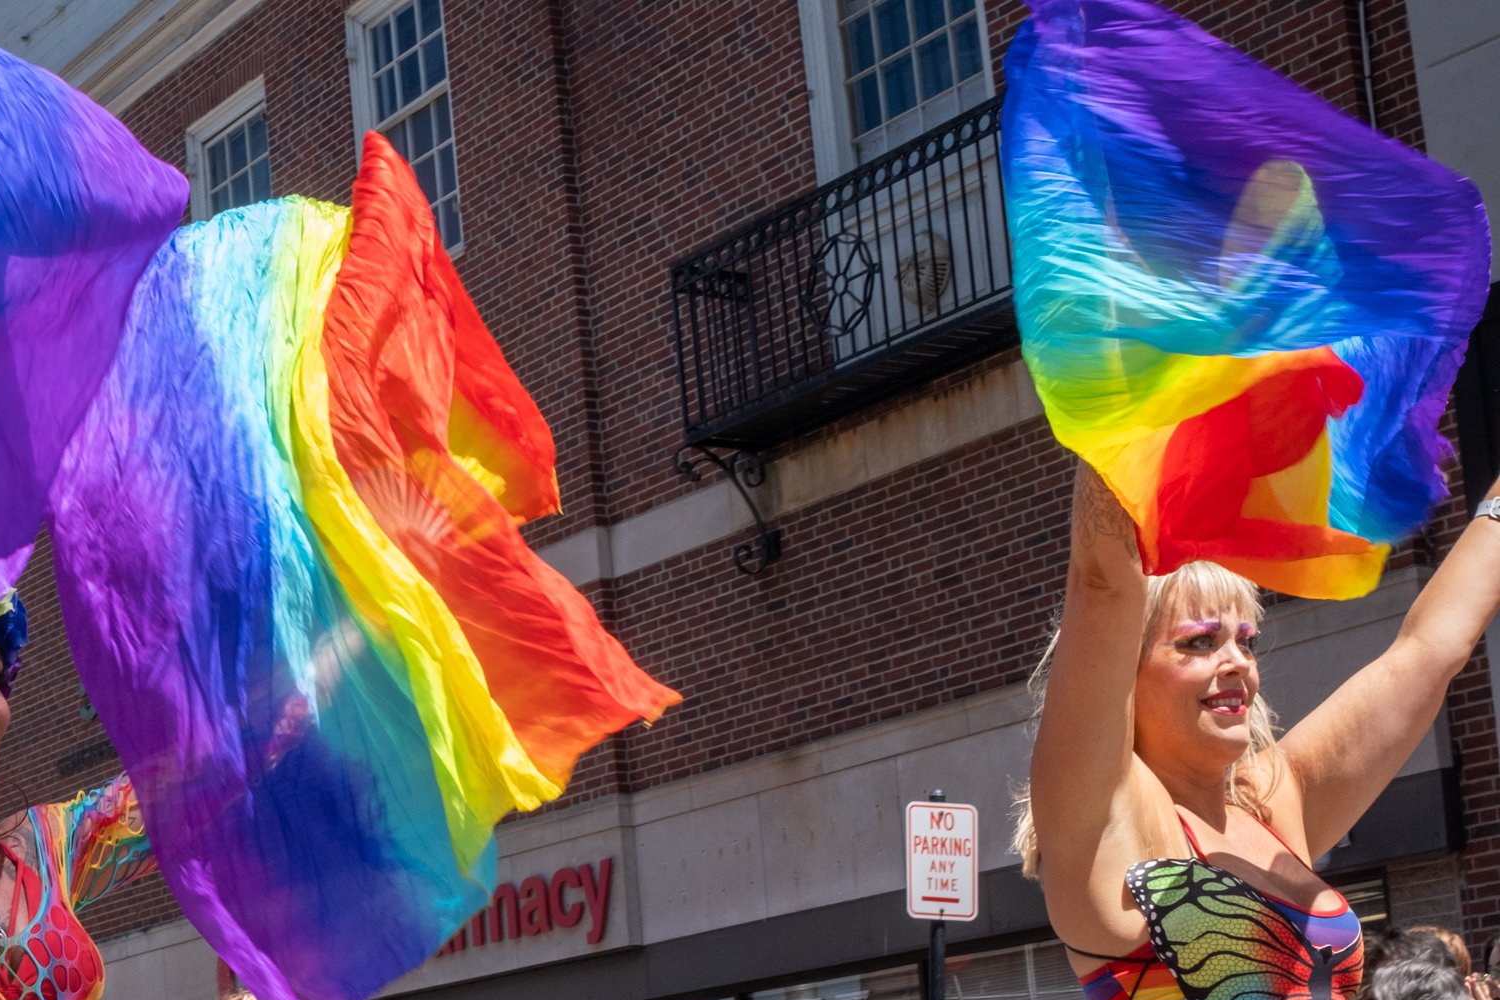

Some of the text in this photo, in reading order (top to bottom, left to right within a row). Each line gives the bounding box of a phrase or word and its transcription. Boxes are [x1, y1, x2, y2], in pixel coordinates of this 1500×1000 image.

[930, 812, 955, 831] NO
[913, 835, 971, 857] PARKING
[929, 860, 955, 873] ANY
[927, 877, 958, 892] TIME
[439, 857, 613, 957] macy
